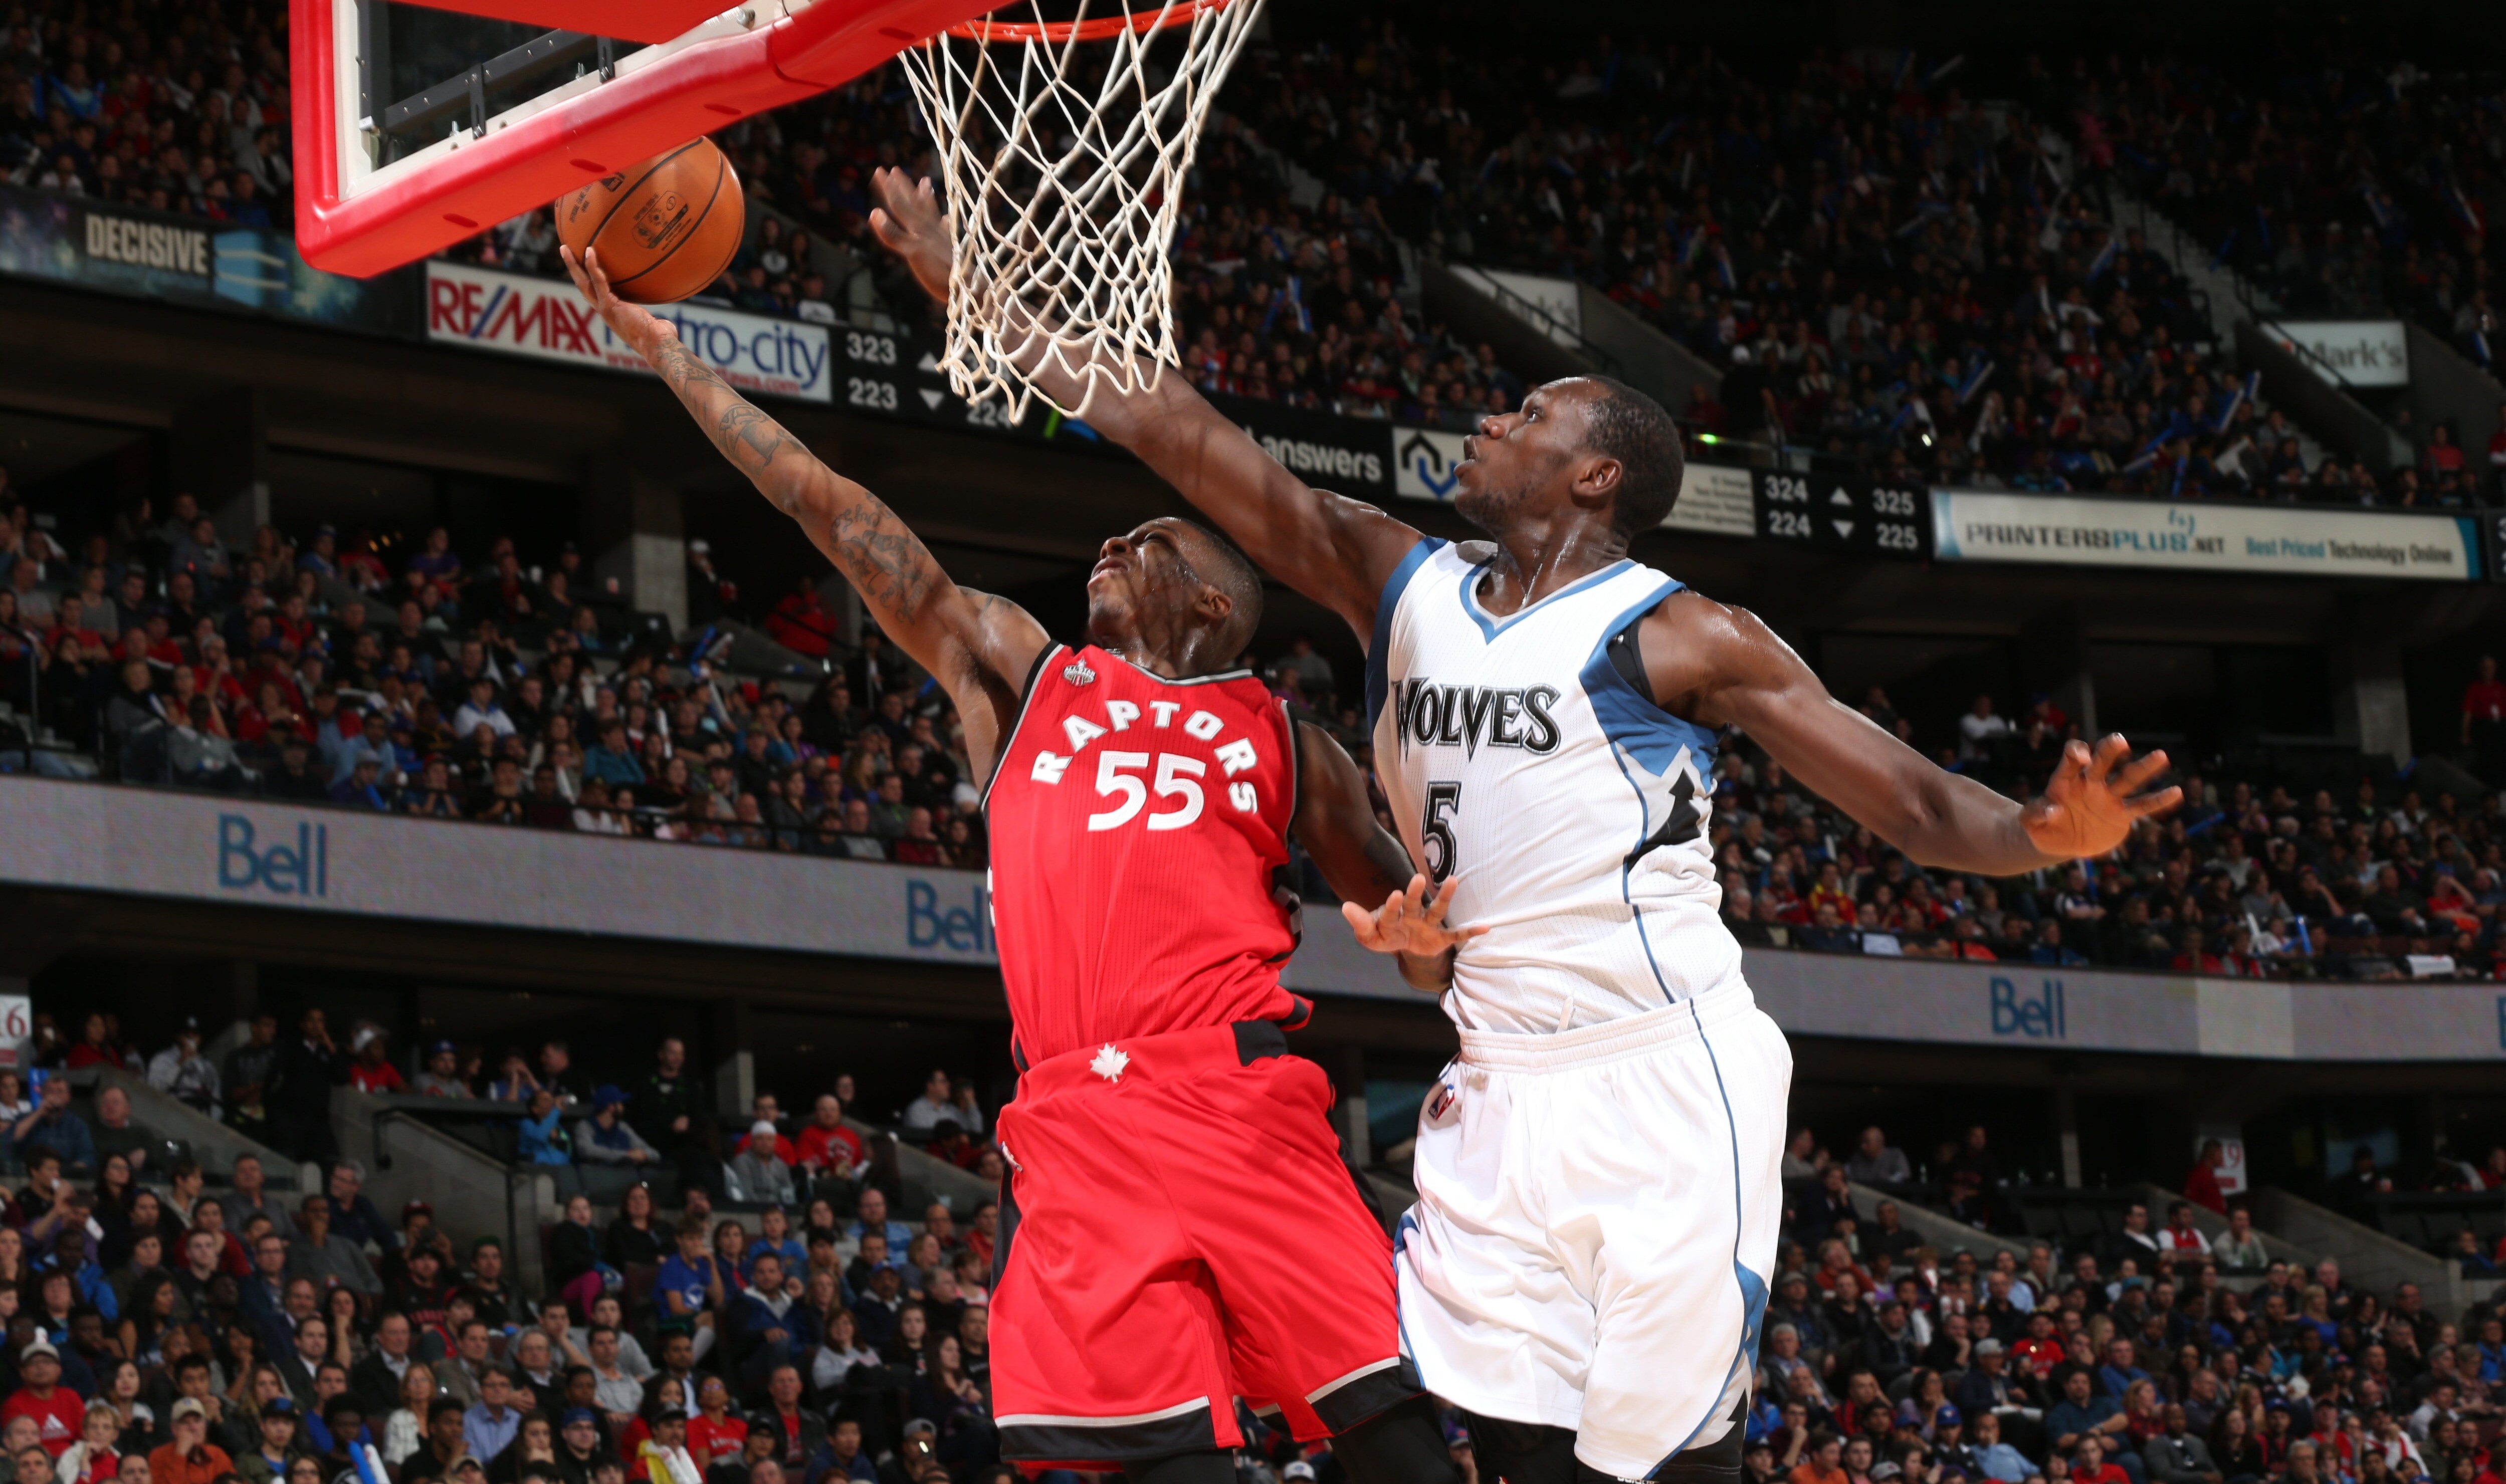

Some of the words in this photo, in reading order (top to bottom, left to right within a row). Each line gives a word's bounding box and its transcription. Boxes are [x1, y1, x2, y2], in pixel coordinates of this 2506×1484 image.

[86, 213, 208, 276] DECISIVE
[430, 277, 600, 356] RE/MAX
[605, 308, 825, 390] tro-city
[847, 332, 897, 365] 323
[849, 377, 898, 410] 223
[1262, 434, 1383, 483] answers
[1765, 475, 1808, 502] 324
[1872, 488, 1916, 516] 325
[1768, 510, 1812, 538] 224
[1876, 522, 1919, 550] 225
[2245, 536, 2276, 556] Best
[2280, 538, 2326, 559] Priced
[2328, 540, 2405, 565] Technology
[2409, 543, 2452, 564] Online
[1392, 677, 1562, 762] WOLVES
[1031, 700, 1259, 815] RAPTORS
[1088, 750, 1206, 831] 55
[218, 812, 327, 897] Bell
[1423, 780, 1461, 888] 5
[0, 1004, 27, 1038] 6
[1990, 976, 2065, 1039] Bell
